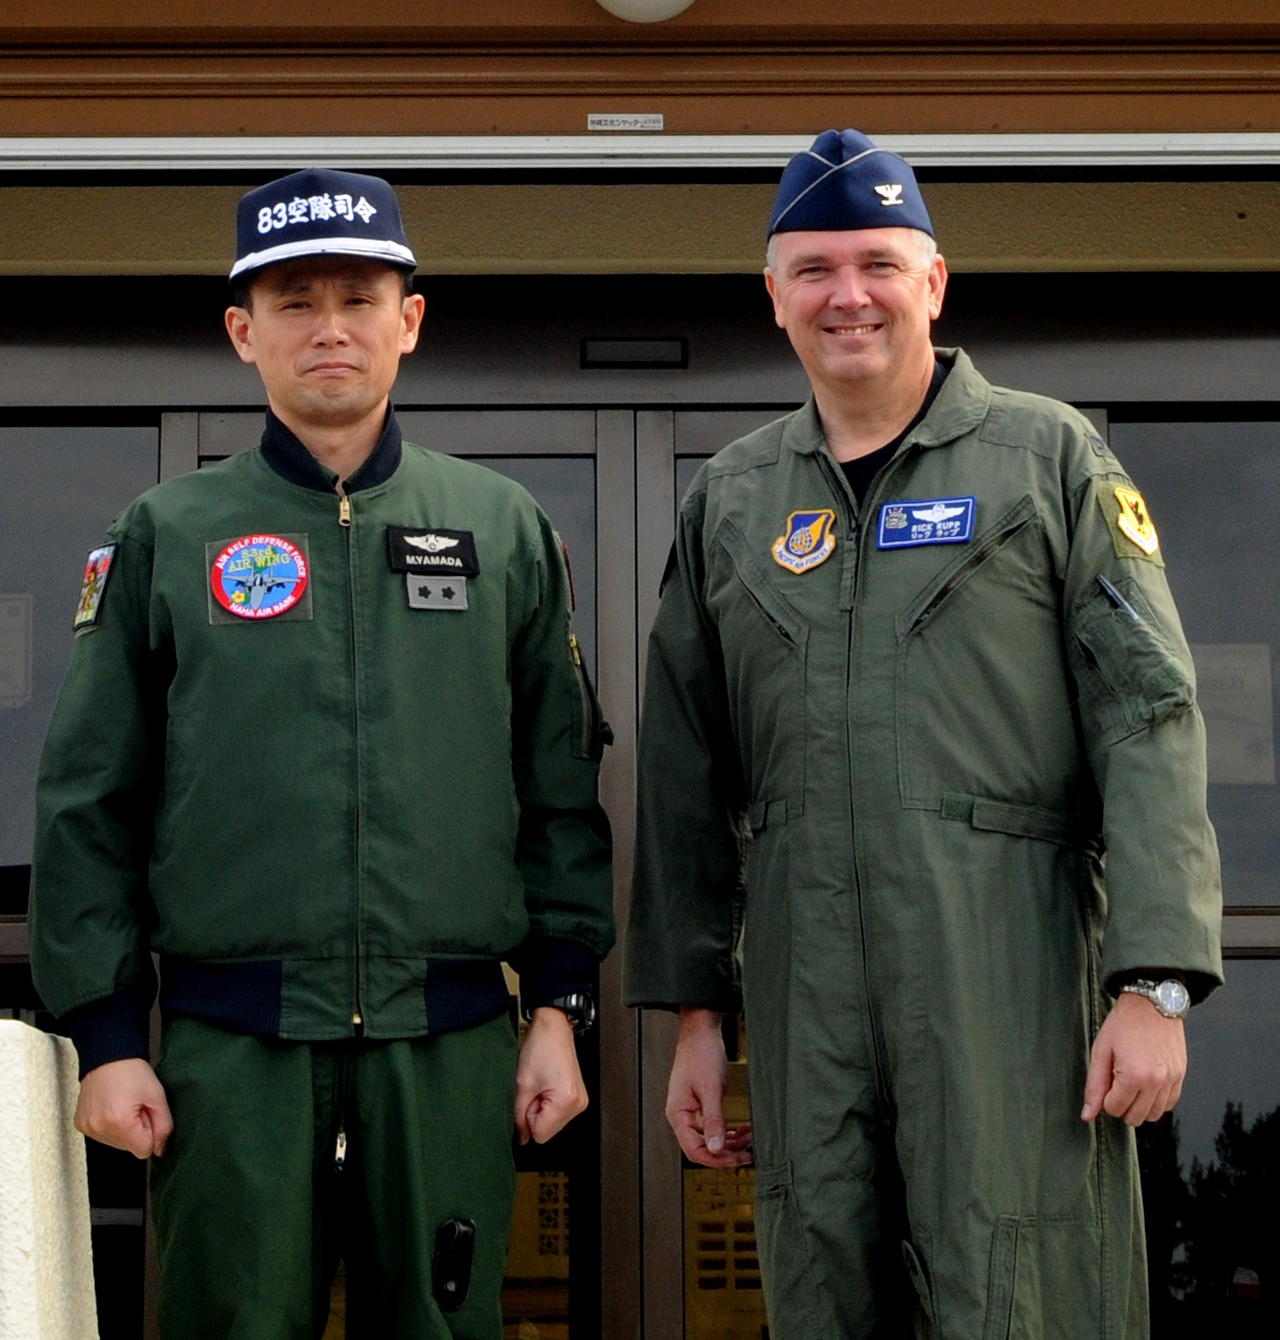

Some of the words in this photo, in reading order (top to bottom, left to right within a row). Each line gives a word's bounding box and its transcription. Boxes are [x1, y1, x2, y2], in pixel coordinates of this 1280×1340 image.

[257, 192, 378, 235] 83空隊司令
[911, 523, 934, 533] RICK
[936, 520, 962, 531] RUPP
[215, 552, 231, 570] AIR
[252, 536, 295, 553] DEFENSE
[228, 558, 253, 573] AIR
[253, 553, 291, 568] WING
